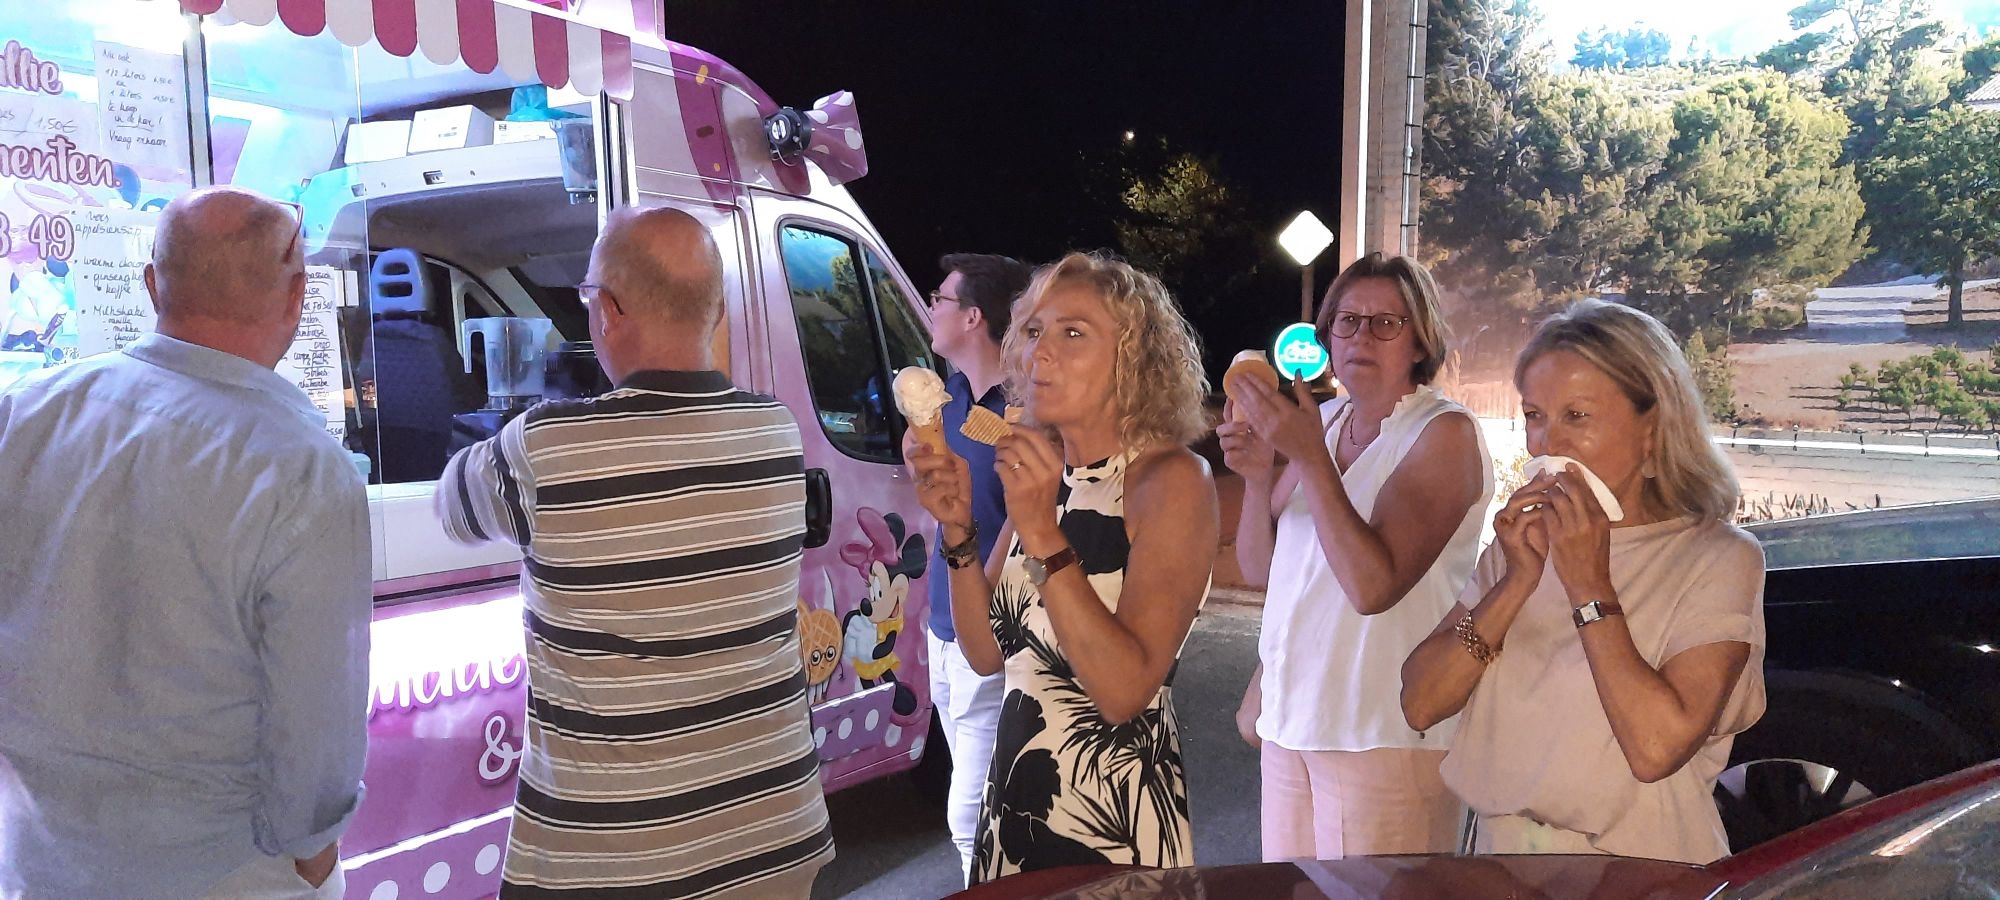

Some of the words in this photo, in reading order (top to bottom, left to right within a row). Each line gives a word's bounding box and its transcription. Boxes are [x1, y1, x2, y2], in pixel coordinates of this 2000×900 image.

[28, 213, 75, 261] 49
[93, 305, 147, 317] Milkshake
[478, 715, 522, 780] &
